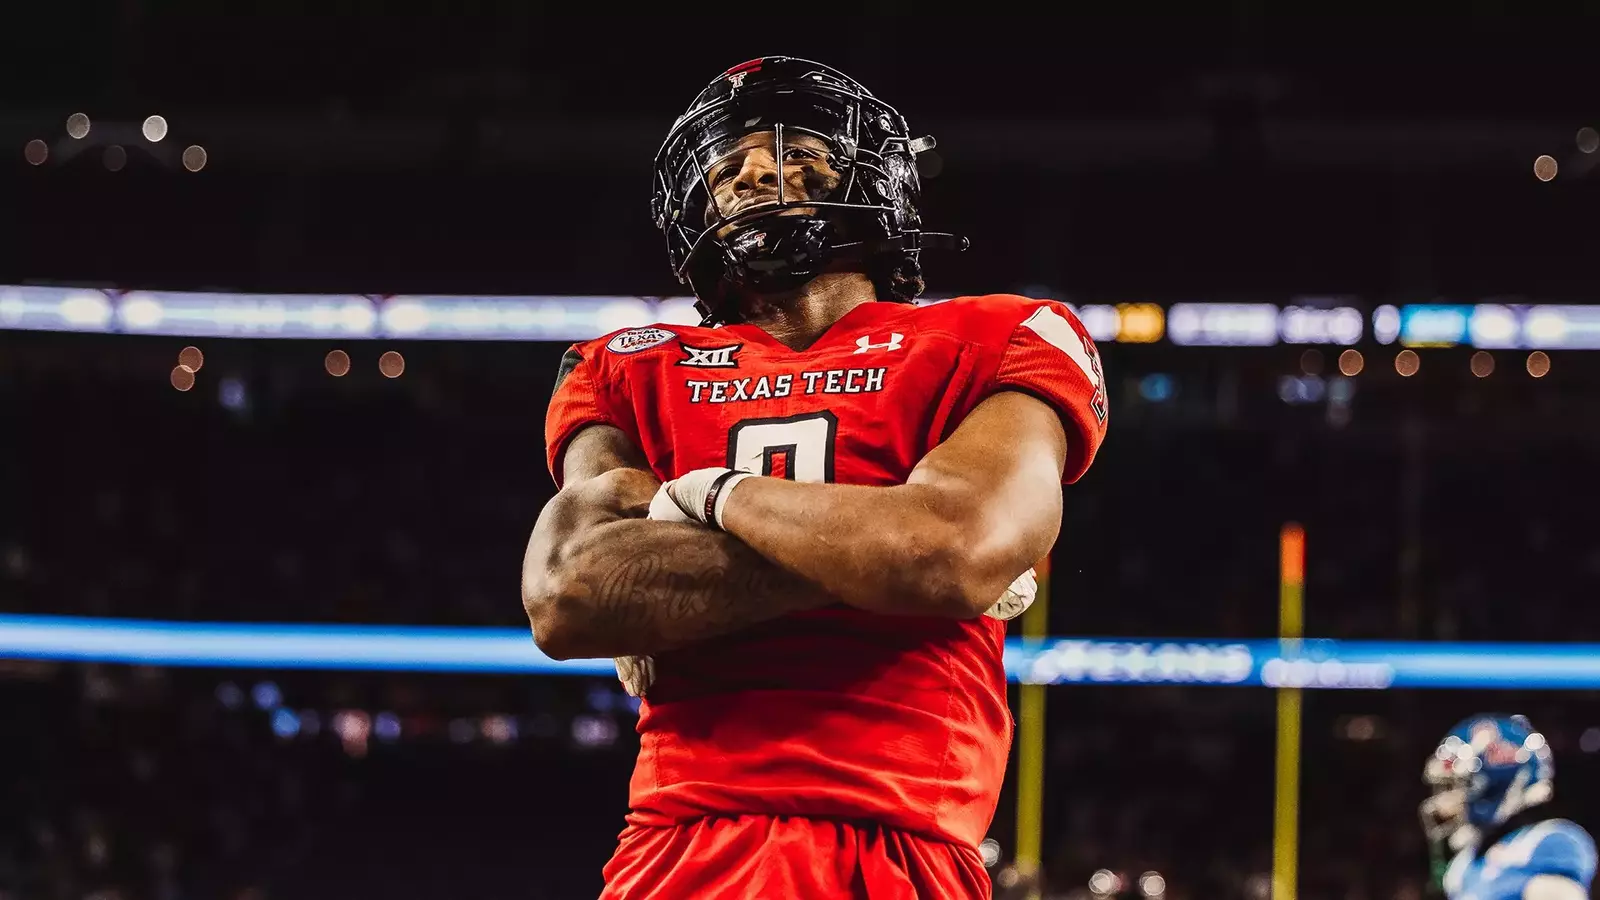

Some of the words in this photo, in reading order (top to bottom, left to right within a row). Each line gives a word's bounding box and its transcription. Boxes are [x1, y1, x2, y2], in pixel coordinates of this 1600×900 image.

[618, 333, 665, 347] TEXAS
[678, 344, 740, 367] XII
[686, 373, 793, 403] TEXAS
[802, 367, 886, 394] TECH
